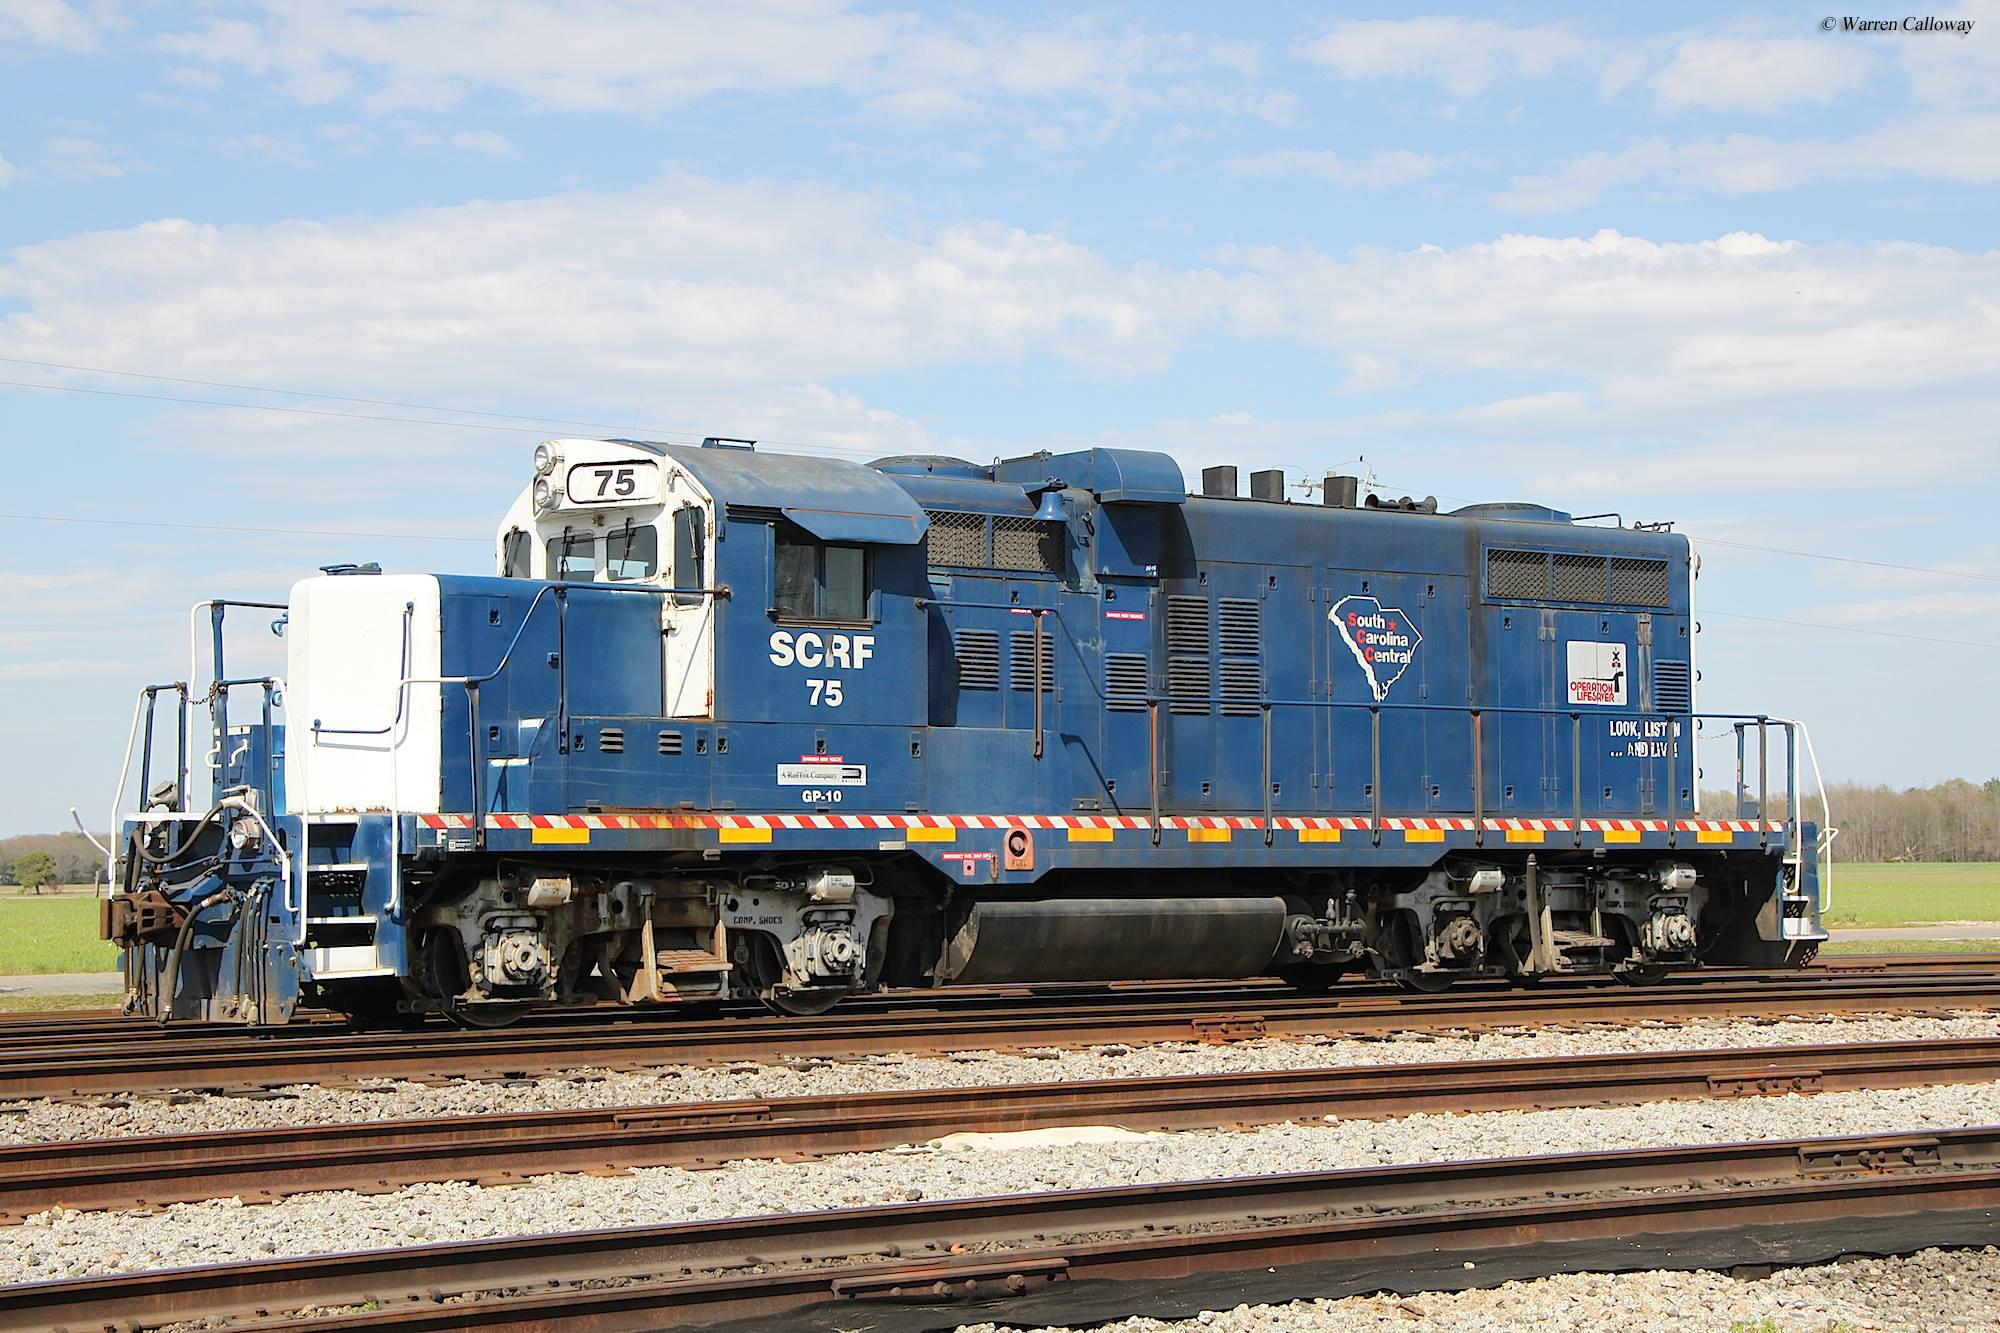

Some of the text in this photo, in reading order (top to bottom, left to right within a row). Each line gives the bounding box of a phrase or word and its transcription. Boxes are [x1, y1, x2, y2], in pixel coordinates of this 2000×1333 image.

[594, 469, 635, 496] 75
[1347, 612, 1386, 629] South
[1356, 629, 1409, 646] Carolina
[769, 631, 875, 669] SCRF
[1364, 647, 1411, 664] Central
[806, 679, 844, 707] 75
[1570, 681, 1613, 693] OPERATION
[1577, 692, 1615, 702] LIFESAVER
[1609, 721, 1681, 739] LOOK, LISTN
[1627, 742, 1649, 757] AND
[1650, 742, 1678, 758] LIV!
[810, 771, 837, 780] Company
[802, 790, 842, 803] GP-10
[437, 829, 448, 845] F
[1011, 859, 1027, 867] FUEL
[733, 916, 783, 925] COMP. SHOES
